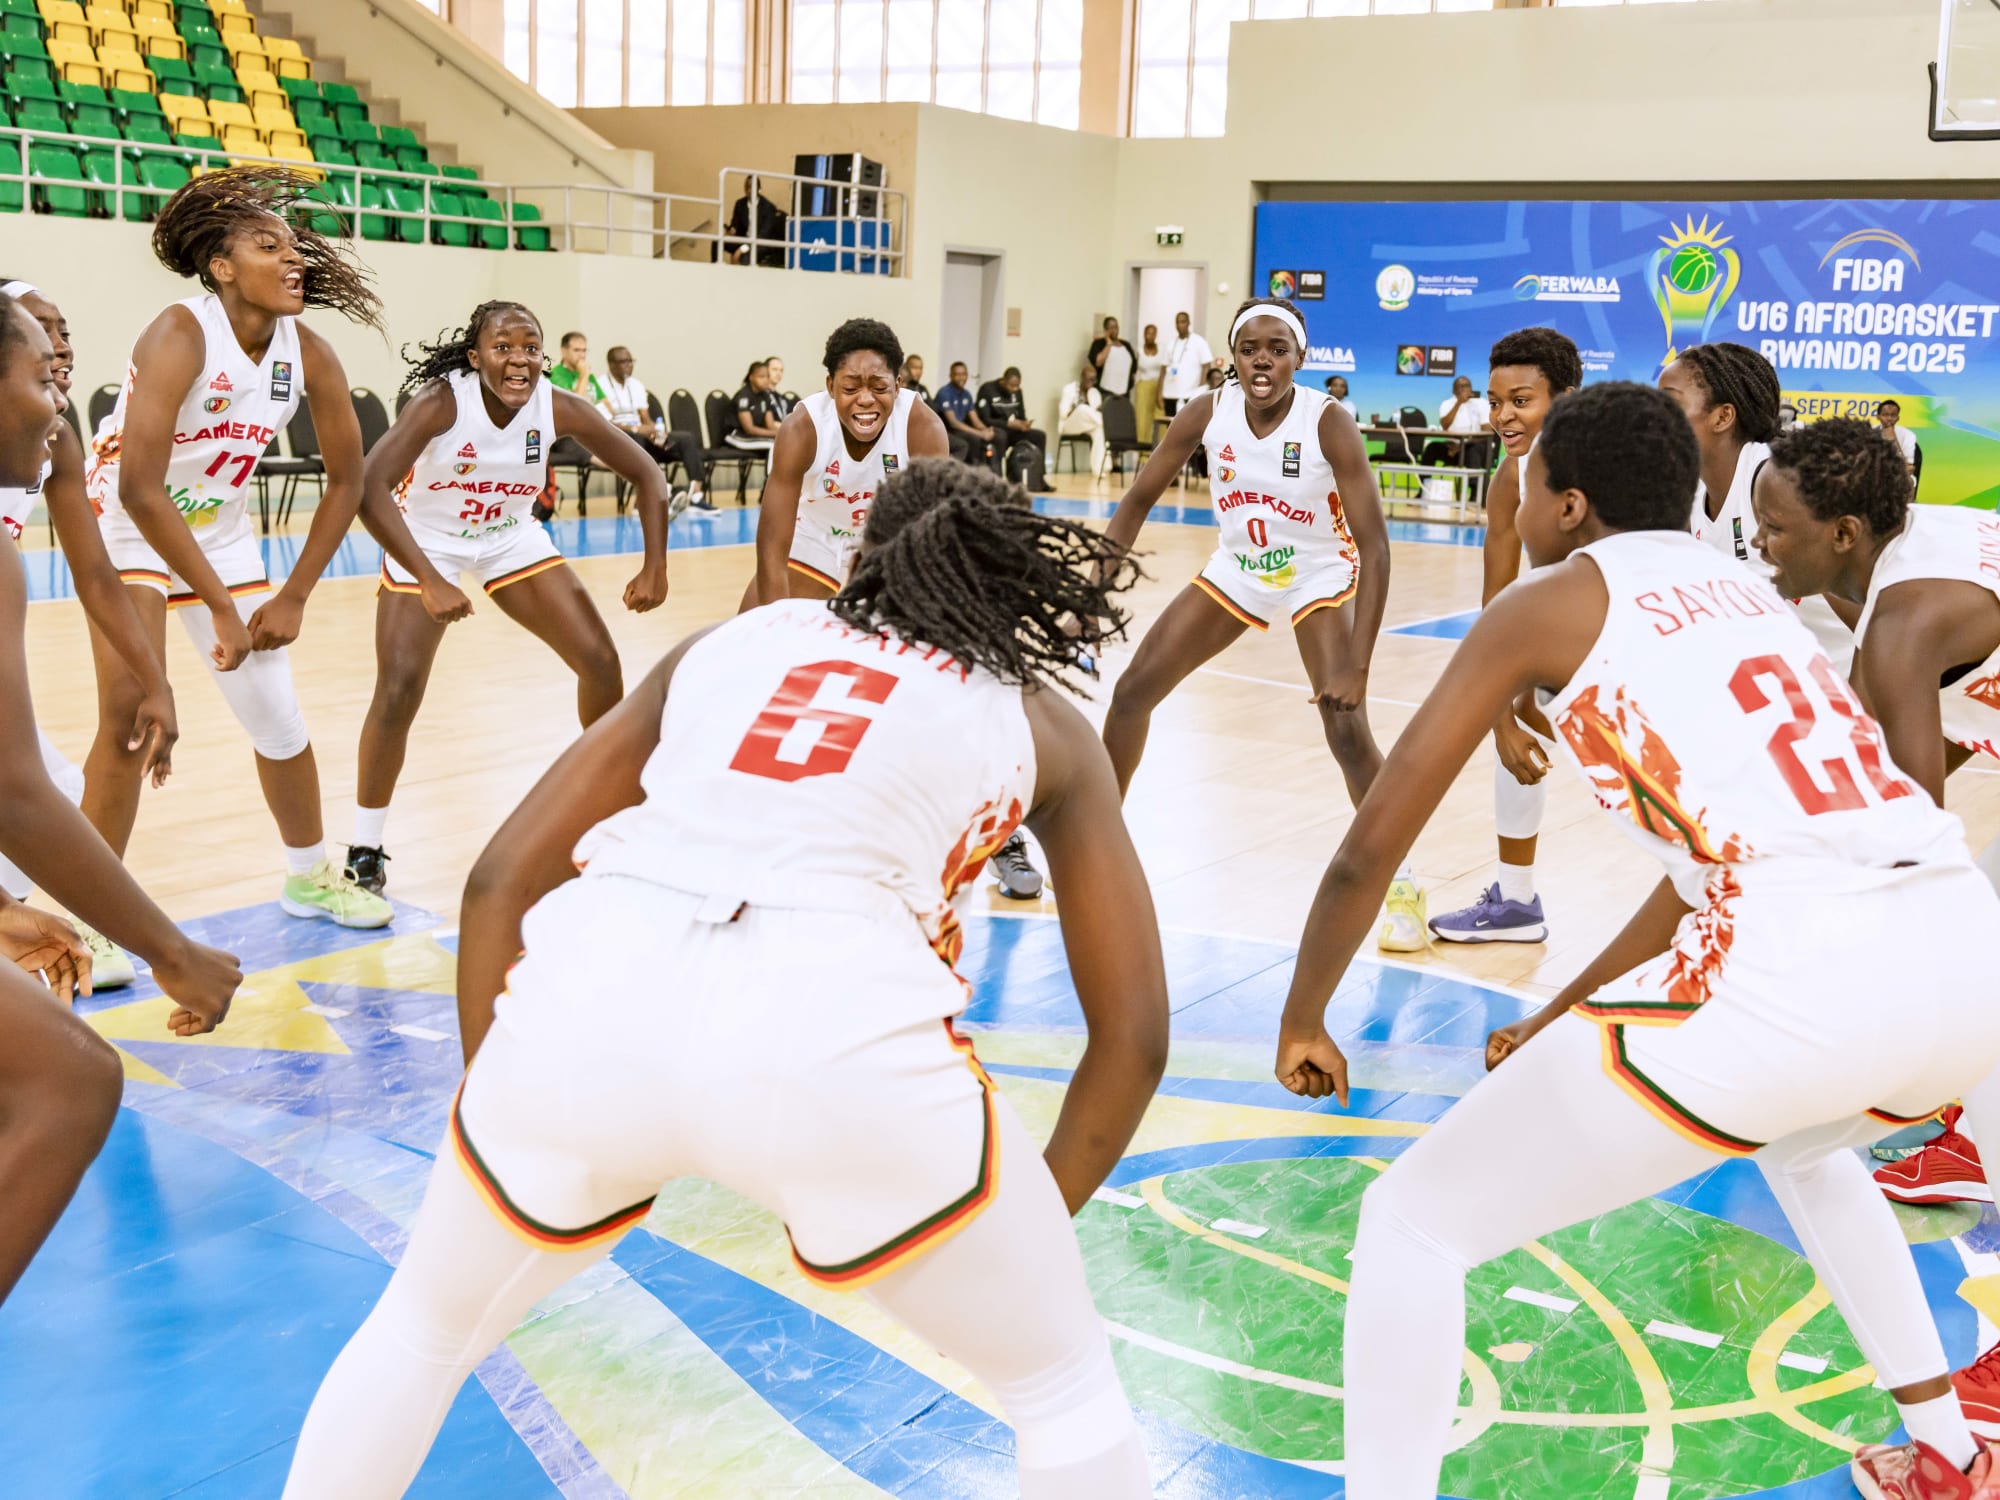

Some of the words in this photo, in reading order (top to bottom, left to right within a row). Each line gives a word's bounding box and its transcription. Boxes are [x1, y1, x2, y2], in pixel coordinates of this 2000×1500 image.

[1540, 276, 1620, 293] FERWABA
[1833, 259, 1904, 291] FIBA
[1452, 287, 1472, 296] Sports
[1738, 302, 1788, 331] U16
[1794, 302, 1999, 337] AFROBASKET
[1760, 340, 1881, 371] RWANDA
[1888, 343, 1965, 373] 2025
[1797, 399, 1842, 415] SEPT
[1847, 400, 1882, 417] 202
[174, 420, 274, 446] CAMERO
[205, 450, 257, 488] 17
[428, 481, 539, 497] CAMEROO
[1218, 489, 1316, 528] AMEROON
[1247, 517, 1268, 548] 0
[728, 660, 899, 783] 6
